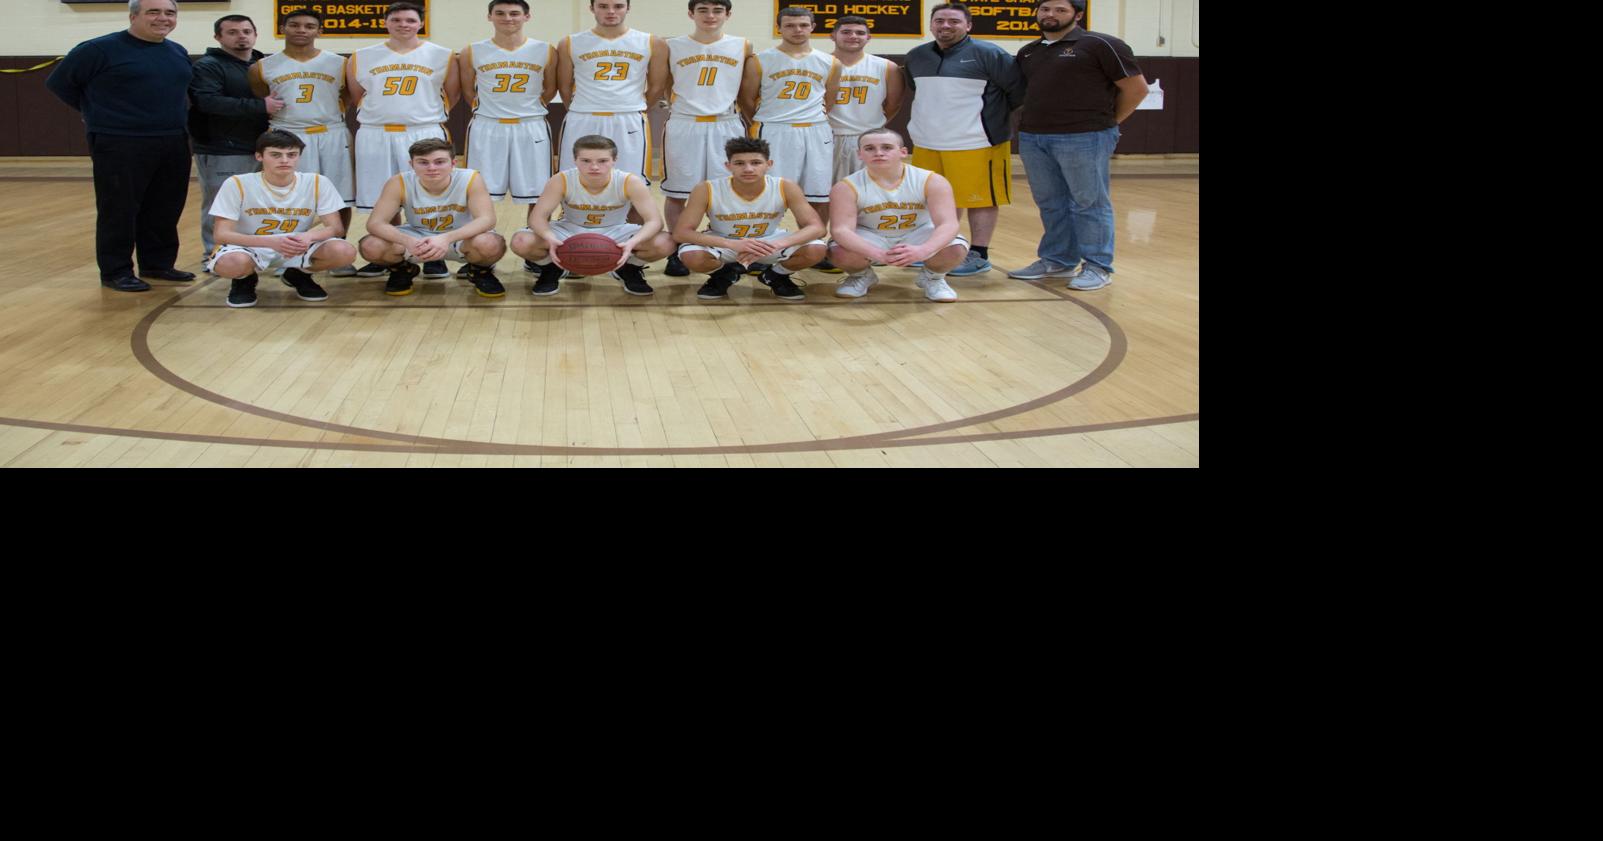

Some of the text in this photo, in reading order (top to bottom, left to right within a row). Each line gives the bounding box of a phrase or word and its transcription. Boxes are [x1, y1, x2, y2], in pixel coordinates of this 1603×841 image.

[281, 5, 321, 15] GIS
[789, 4, 910, 15] ELD HOCKEY
[968, 6, 1038, 16] SOFTB
[321, 19, 386, 29] 014-1
[996, 20, 1040, 31] 2014
[594, 62, 630, 81] 23
[697, 66, 718, 86] 11
[382, 75, 419, 96] 50
[492, 73, 530, 93] 32
[777, 80, 812, 100] 20
[295, 83, 315, 104] 3
[836, 86, 869, 105] 34
[254, 219, 300, 236] 24
[420, 214, 454, 232] 42
[583, 213, 606, 225] 5
[877, 213, 918, 231] 22
[727, 222, 770, 238] 33
